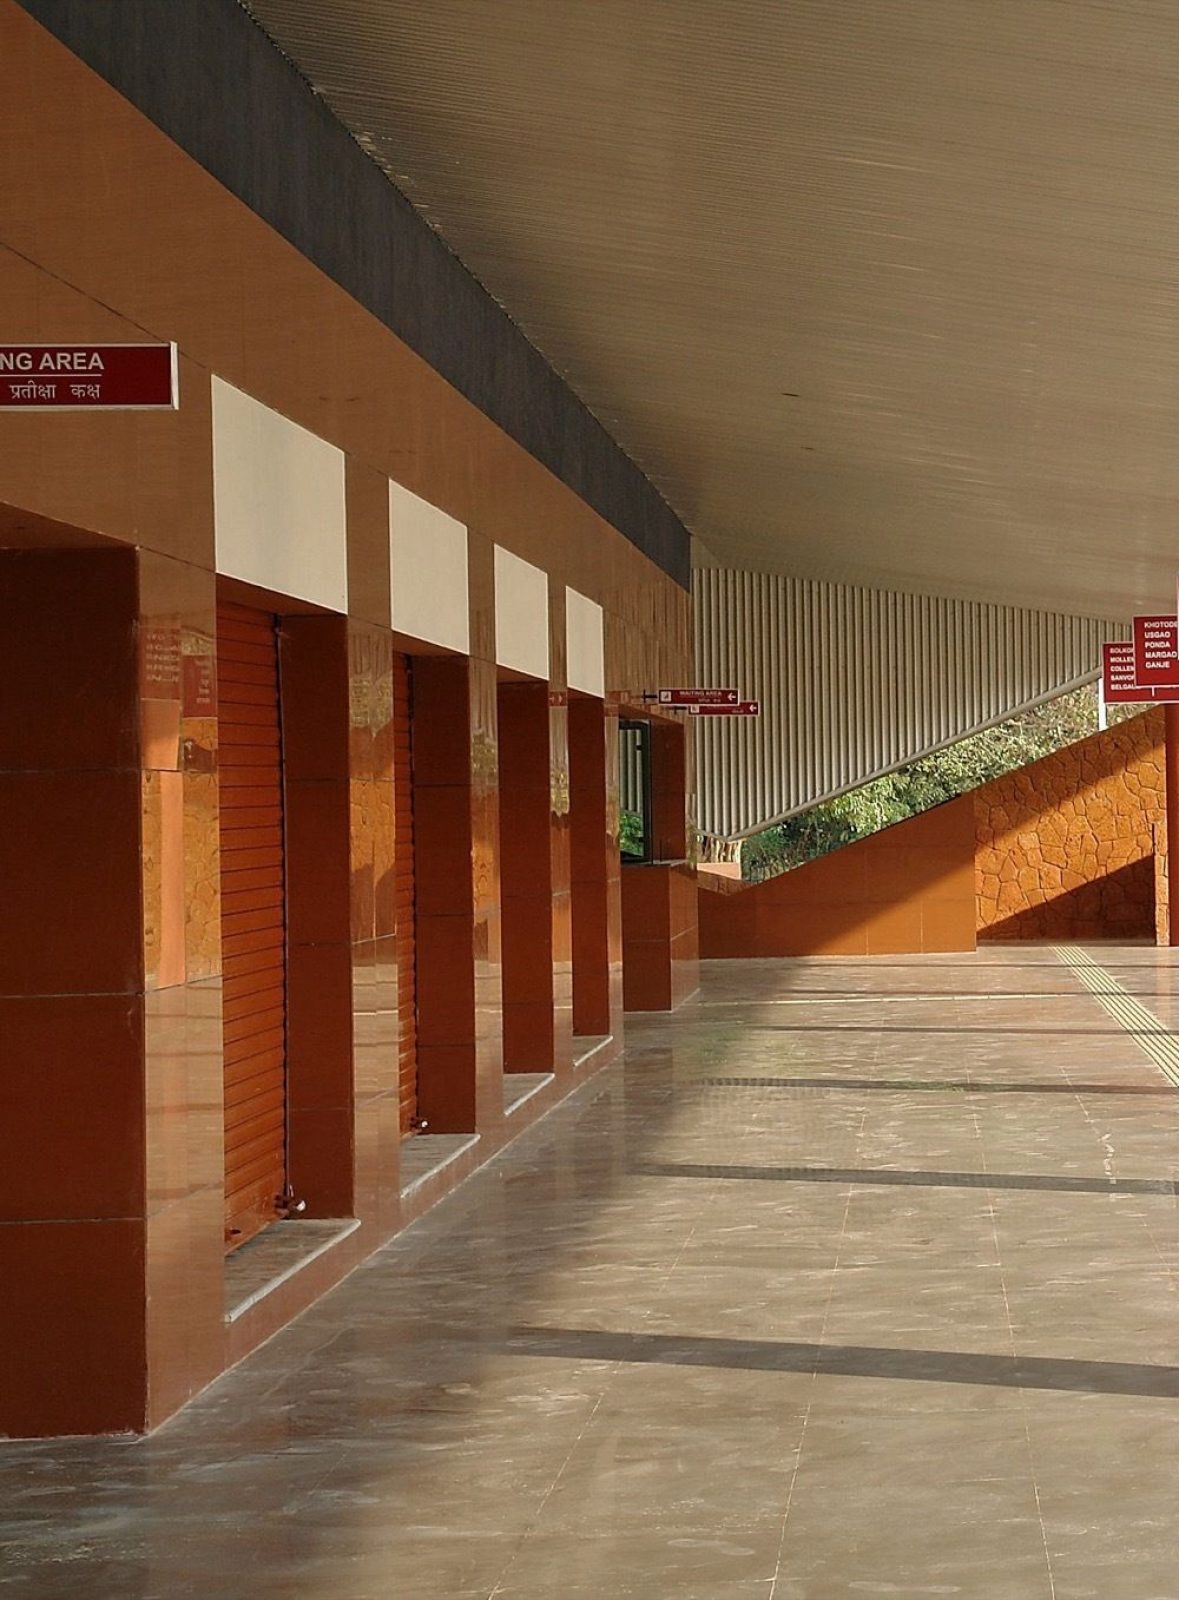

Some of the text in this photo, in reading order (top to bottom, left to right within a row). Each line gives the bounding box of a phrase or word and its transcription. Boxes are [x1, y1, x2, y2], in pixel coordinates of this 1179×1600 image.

[39, 352, 105, 370] AREA
[9, 380, 101, 400] प्रतीक्षा कक्ष
[1144, 631, 1171, 639] USGAO
[1144, 641, 1171, 649] PONDA
[1144, 651, 1177, 659] MARGAO
